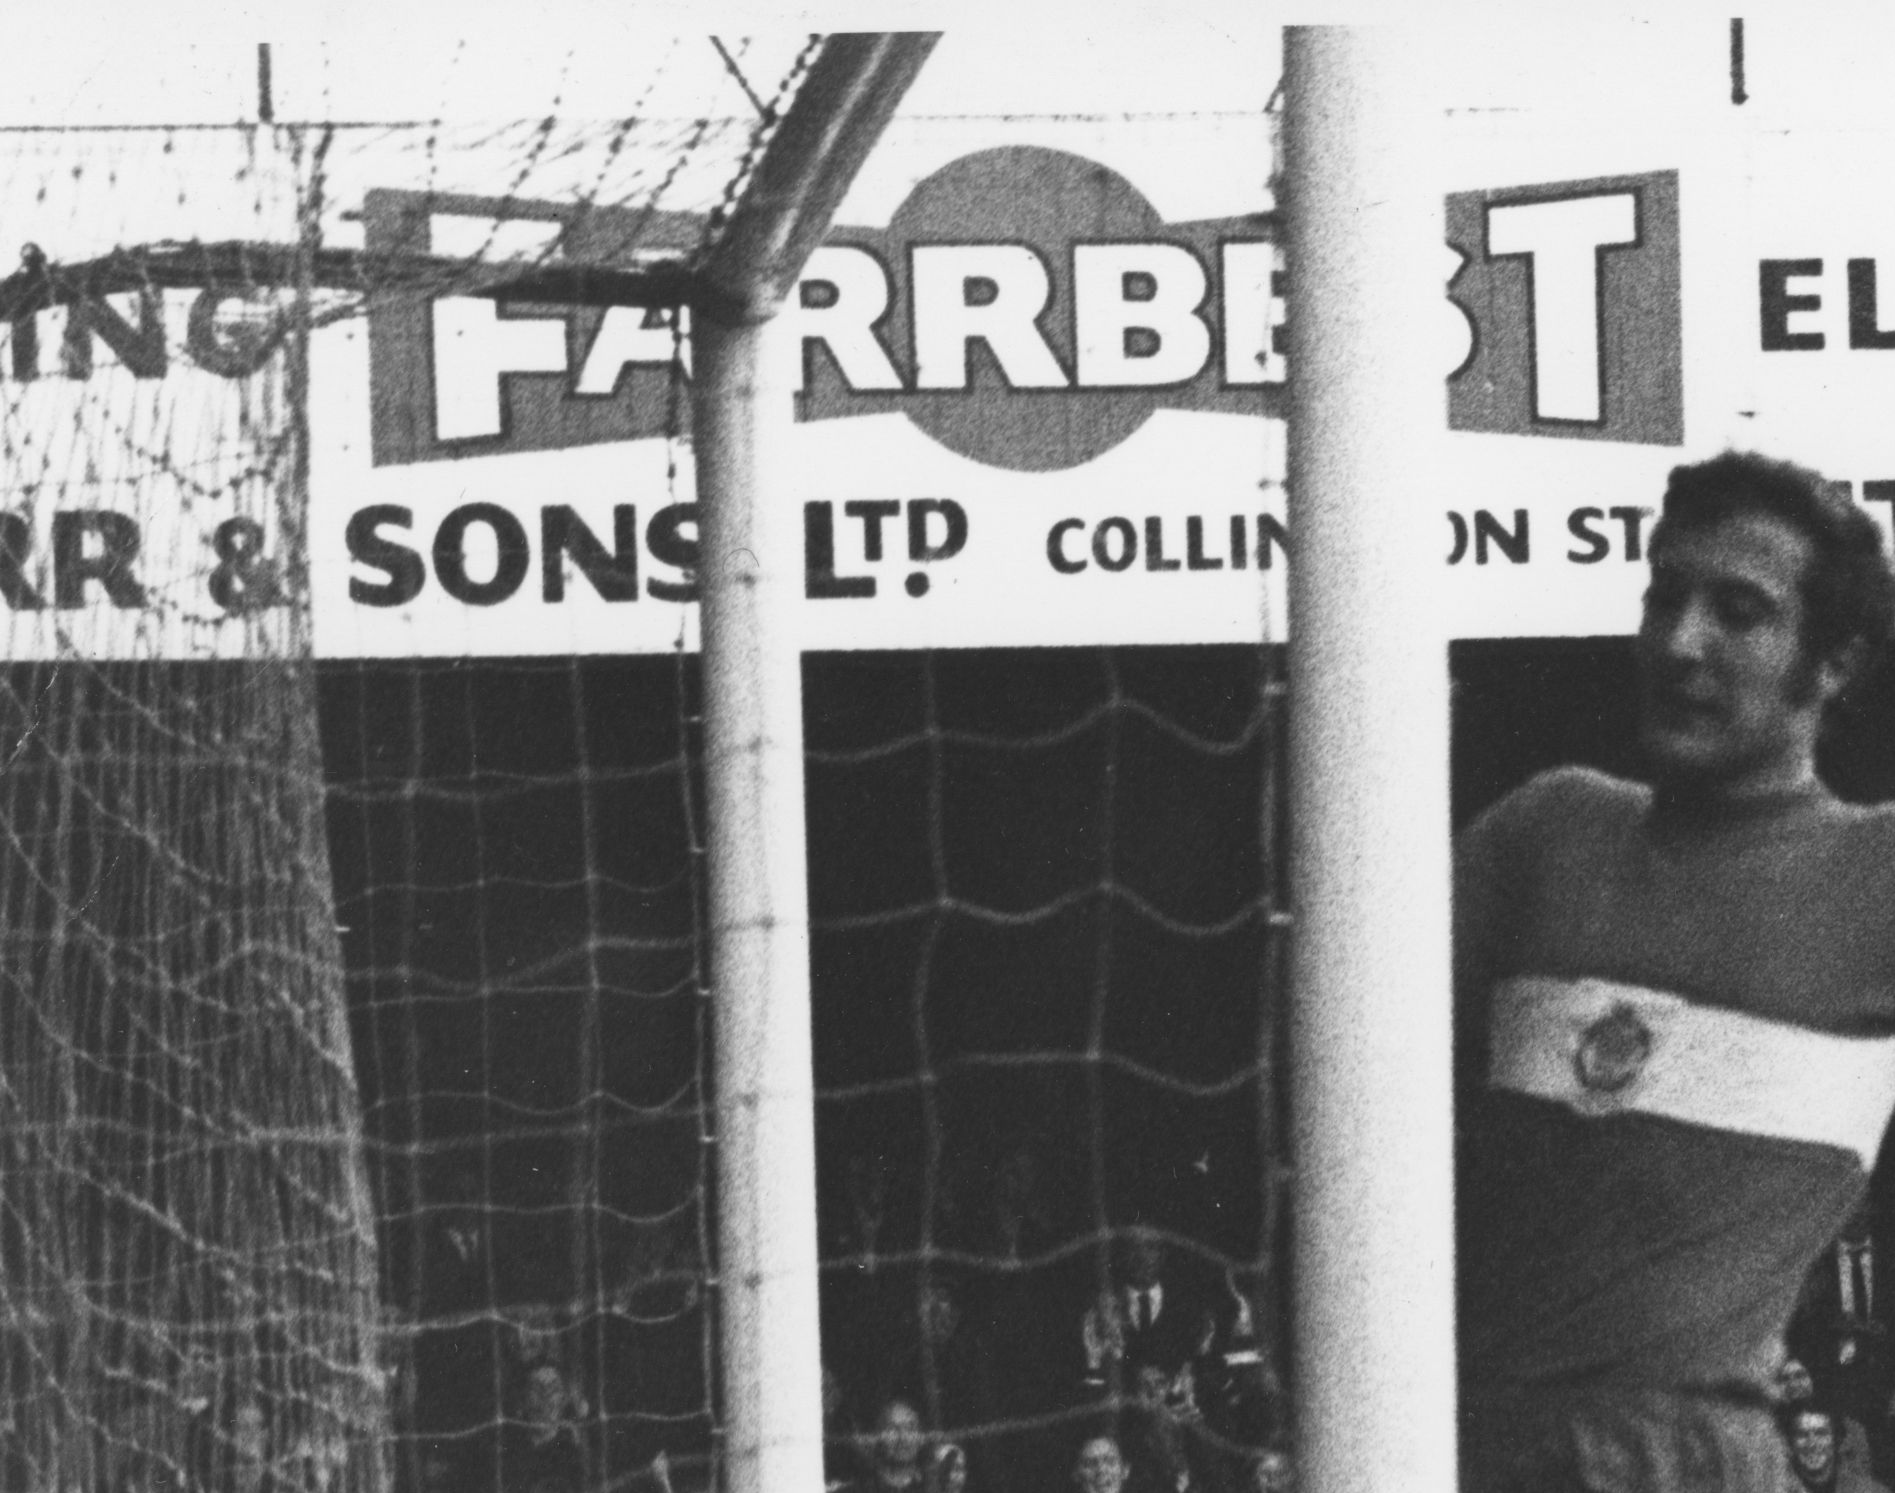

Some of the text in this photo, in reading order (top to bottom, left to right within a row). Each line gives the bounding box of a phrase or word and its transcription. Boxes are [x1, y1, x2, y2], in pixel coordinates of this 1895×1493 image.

[430, 192, 1638, 441] FARRBET
[208, 514, 298, 618] &
[345, 502, 702, 606] SONS
